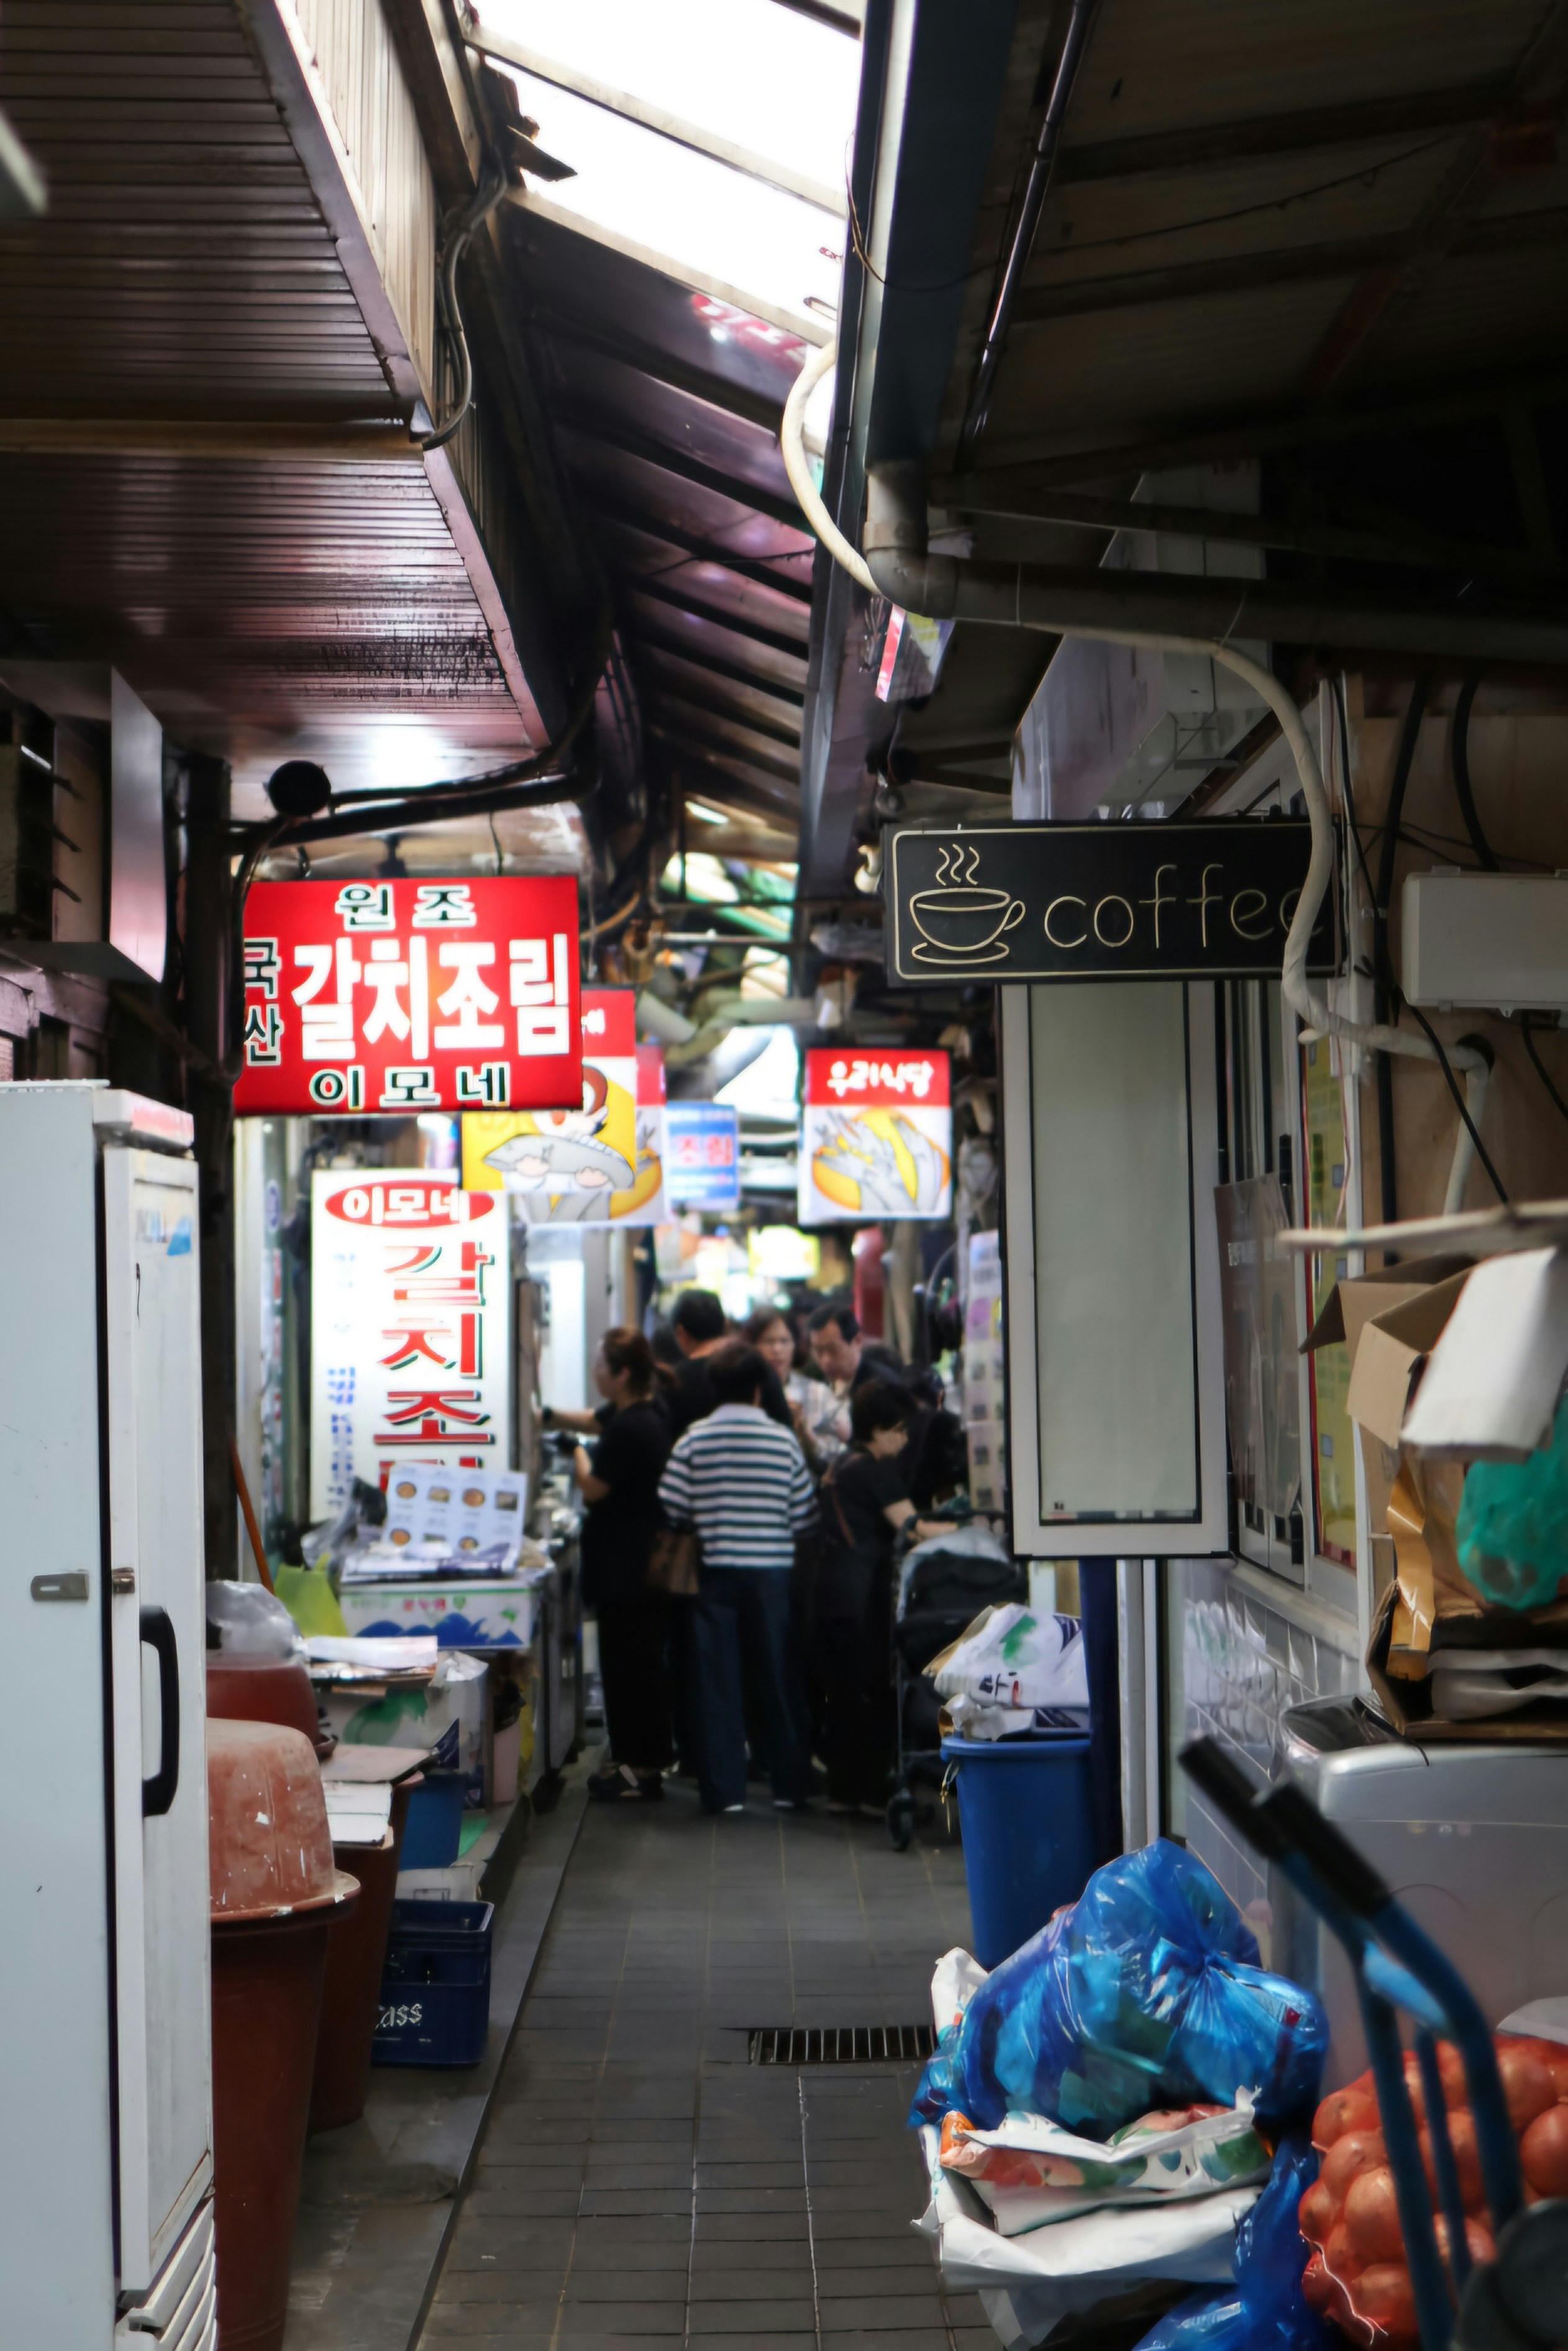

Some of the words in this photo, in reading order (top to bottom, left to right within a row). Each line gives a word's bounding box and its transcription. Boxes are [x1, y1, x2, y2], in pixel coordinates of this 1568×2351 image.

[335, 883, 476, 931] 원조
[244, 938, 284, 1066] 국산
[291, 934, 570, 1060] 갈치조림
[309, 1062, 511, 1111] 이모네
[342, 1186, 471, 1225] 이모네
[373, 1241, 496, 1492] 갈치조
[374, 2002, 423, 2030] ASS
